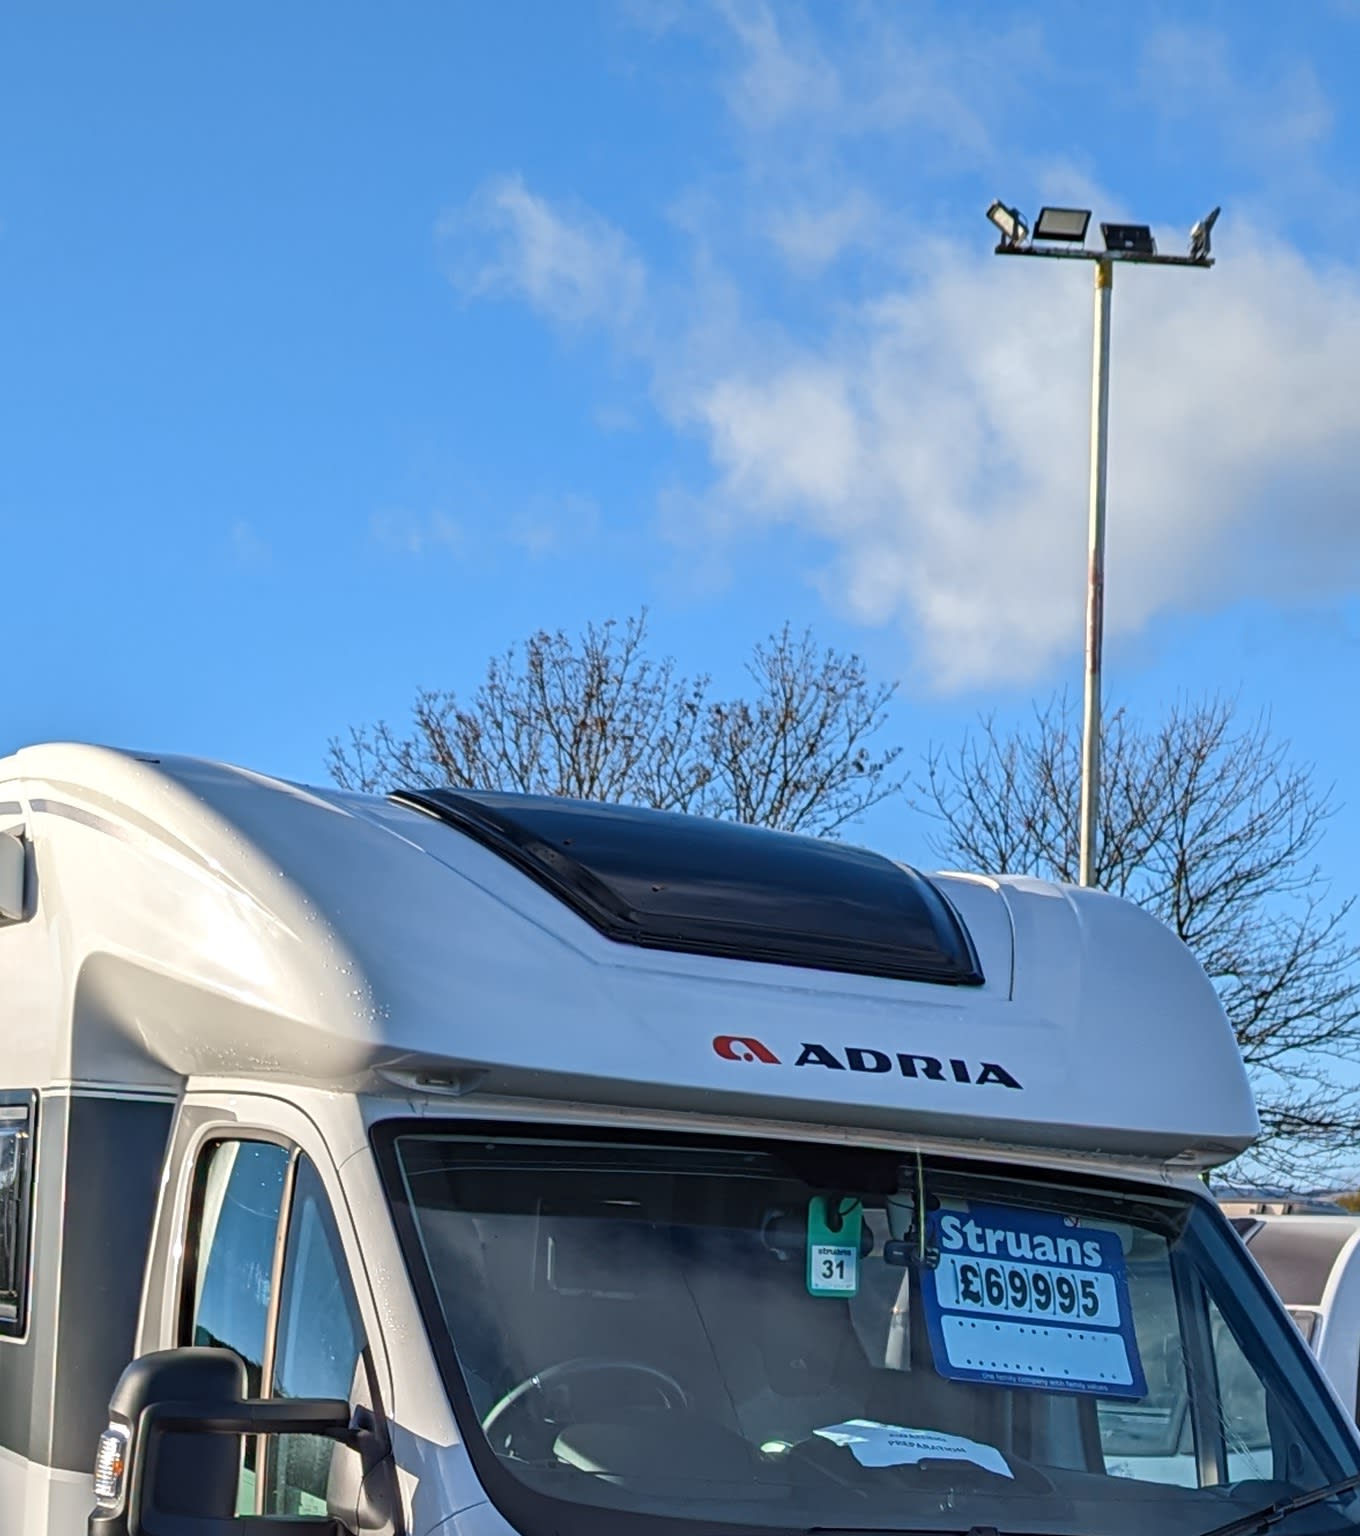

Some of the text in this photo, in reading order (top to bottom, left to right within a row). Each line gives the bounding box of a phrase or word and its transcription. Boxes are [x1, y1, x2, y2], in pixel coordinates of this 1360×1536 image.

[794, 1042, 1024, 1090] ADRIA
[818, 1247, 852, 1256] struans
[941, 1215, 1103, 1268] Struans
[822, 1259, 845, 1280] 31
[959, 1263, 1100, 1318] £69995
